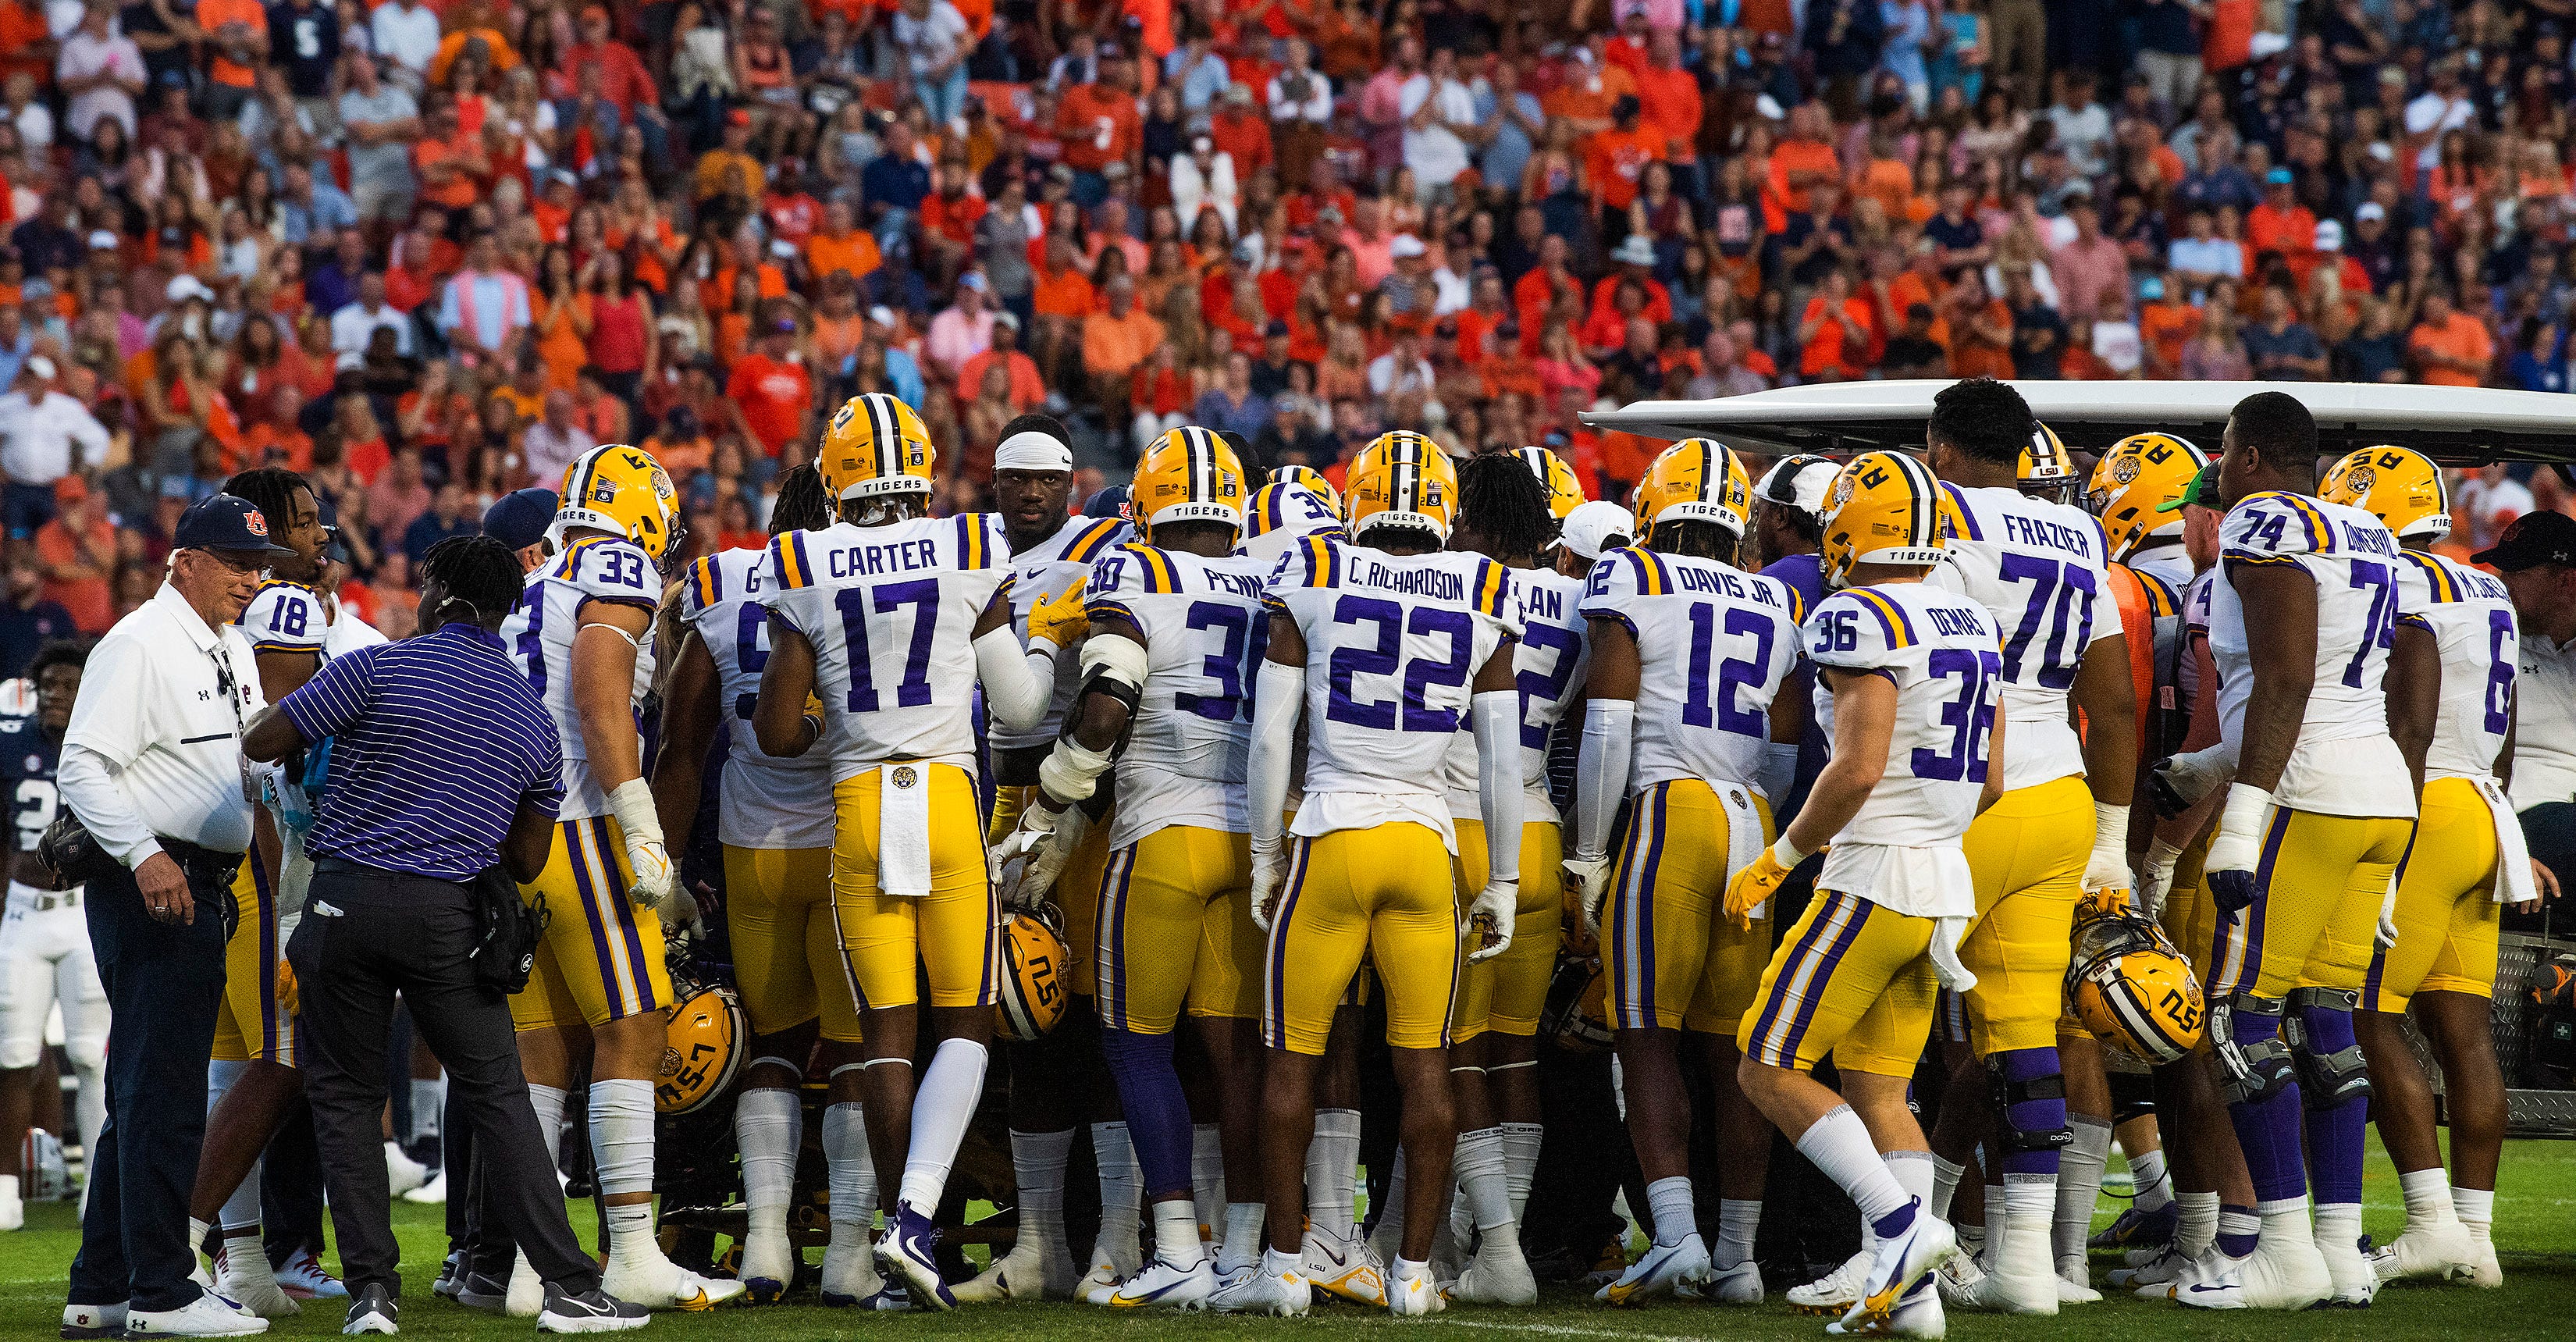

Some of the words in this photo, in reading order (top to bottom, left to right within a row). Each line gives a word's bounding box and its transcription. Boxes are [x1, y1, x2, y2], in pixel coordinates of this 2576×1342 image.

[905, 457, 909, 467] 7
[2039, 467, 2058, 477] LSU
[587, 491, 593, 500] 3
[863, 480, 921, 493] TIGERS
[1182, 486, 1187, 496] 3
[1383, 493, 1389, 503] 2
[1419, 497, 1425, 507] 2
[1727, 492, 1732, 502] 2
[553, 511, 597, 522] TIGERS
[1174, 507, 1229, 518] TIGERS
[1379, 513, 1425, 524] TIGERS
[1681, 505, 1736, 524] TIGERS
[2238, 508, 2288, 551] 74
[1902, 529, 1909, 539] 3
[2002, 514, 2090, 560] FRAZIER
[599, 550, 644, 590] 33
[829, 539, 938, 578] CARTER
[1889, 551, 1941, 562] TIGERS
[1087, 557, 1126, 596] 30
[1348, 556, 1363, 586] C.
[1367, 562, 1464, 601] RICHARDSON
[1584, 559, 1617, 600] 12
[1675, 566, 1745, 599] DAVIS
[1751, 578, 1782, 609] JR.
[269, 594, 308, 638] 18
[1813, 610, 1859, 653] 36
[1925, 607, 1987, 637] DEMAS
[1999, 551, 2097, 689] 70
[2341, 557, 2400, 689] 74
[834, 577, 941, 714] 17
[1326, 593, 1474, 733] 22
[1681, 601, 1776, 740] 12
[2483, 609, 2516, 736] 6
[1910, 648, 2004, 784] 36
[1462, 1130, 1491, 1140] NIKE
[1281, 1272, 1299, 1286] NIKE
[1308, 1262, 1326, 1273] LSU
